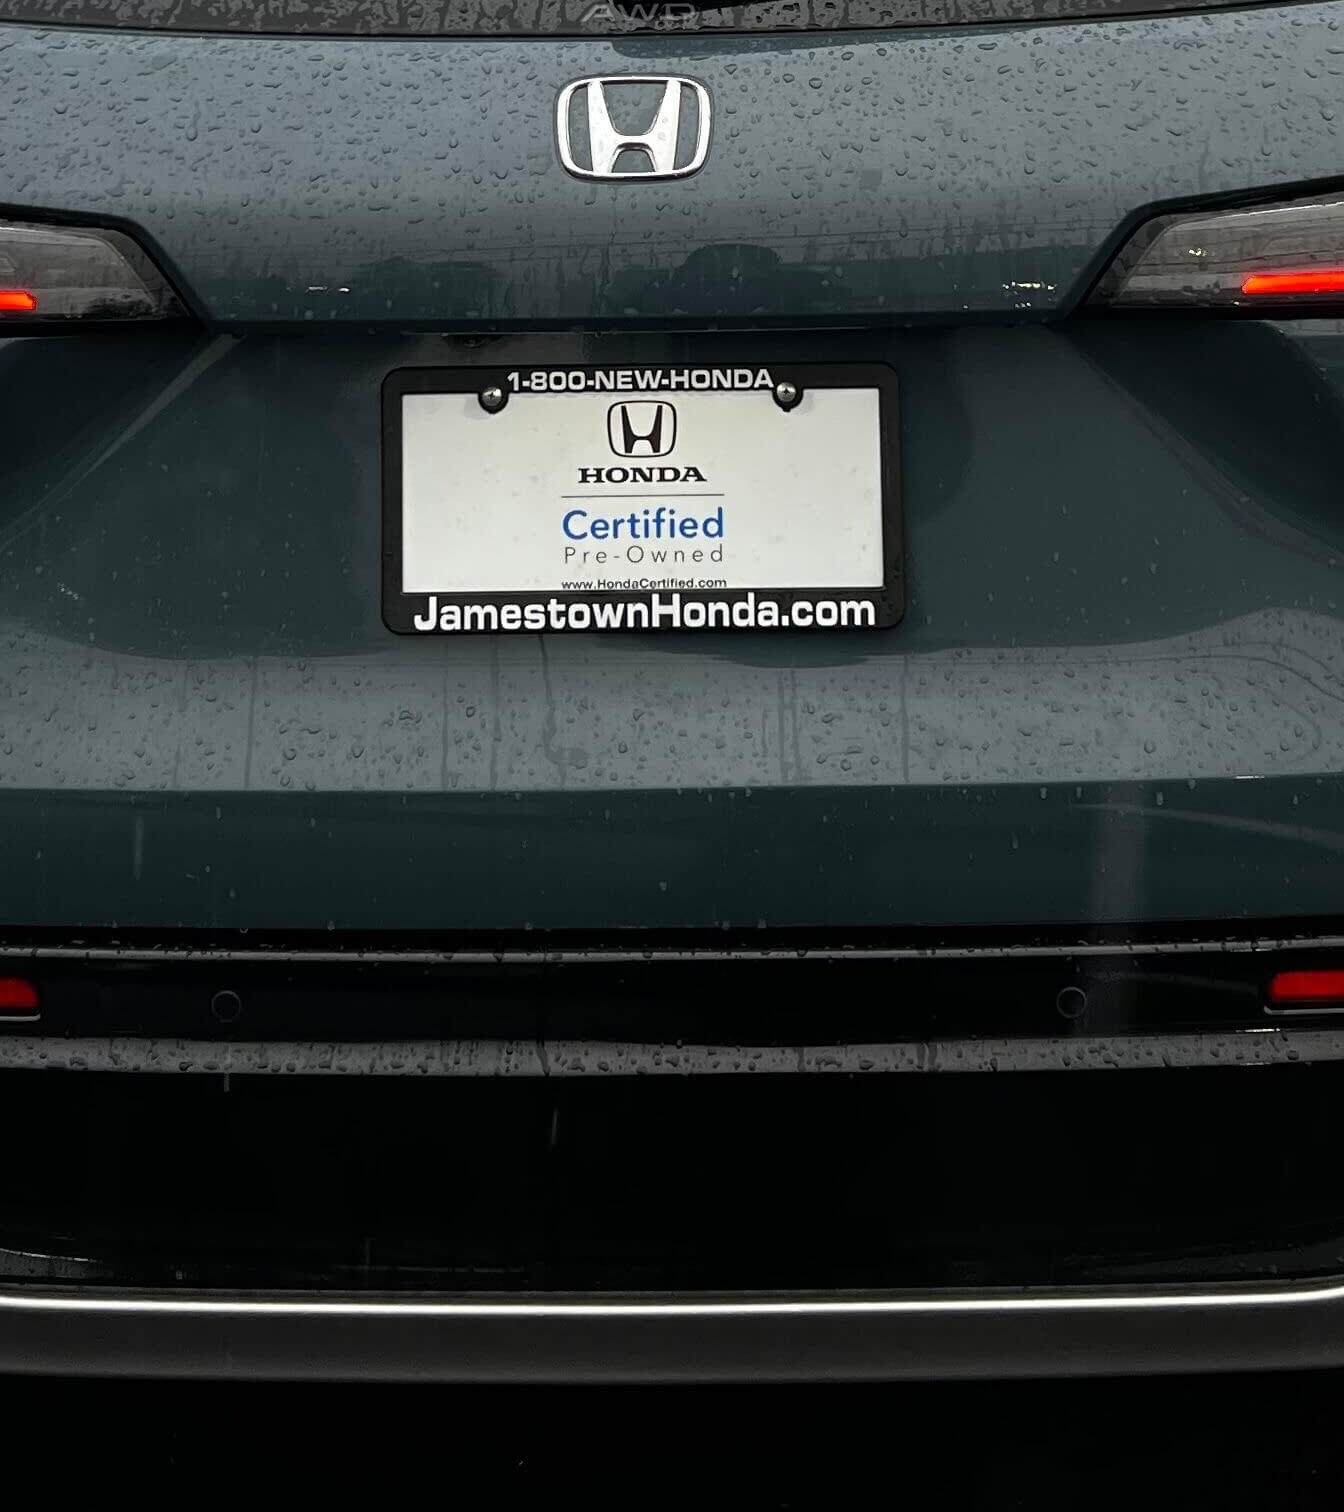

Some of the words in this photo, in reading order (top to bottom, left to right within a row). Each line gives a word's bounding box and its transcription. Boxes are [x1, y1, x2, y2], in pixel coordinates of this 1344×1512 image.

[580, 1, 697, 23] AWD
[507, 369, 775, 391] 1-800-NEW-HONDA
[577, 466, 708, 484] HONDA
[562, 506, 725, 540] Certified
[564, 544, 724, 564] Pre-Owned
[561, 577, 727, 589] www.HondaCertified.com
[413, 592, 877, 632] JamestownHonda.com
